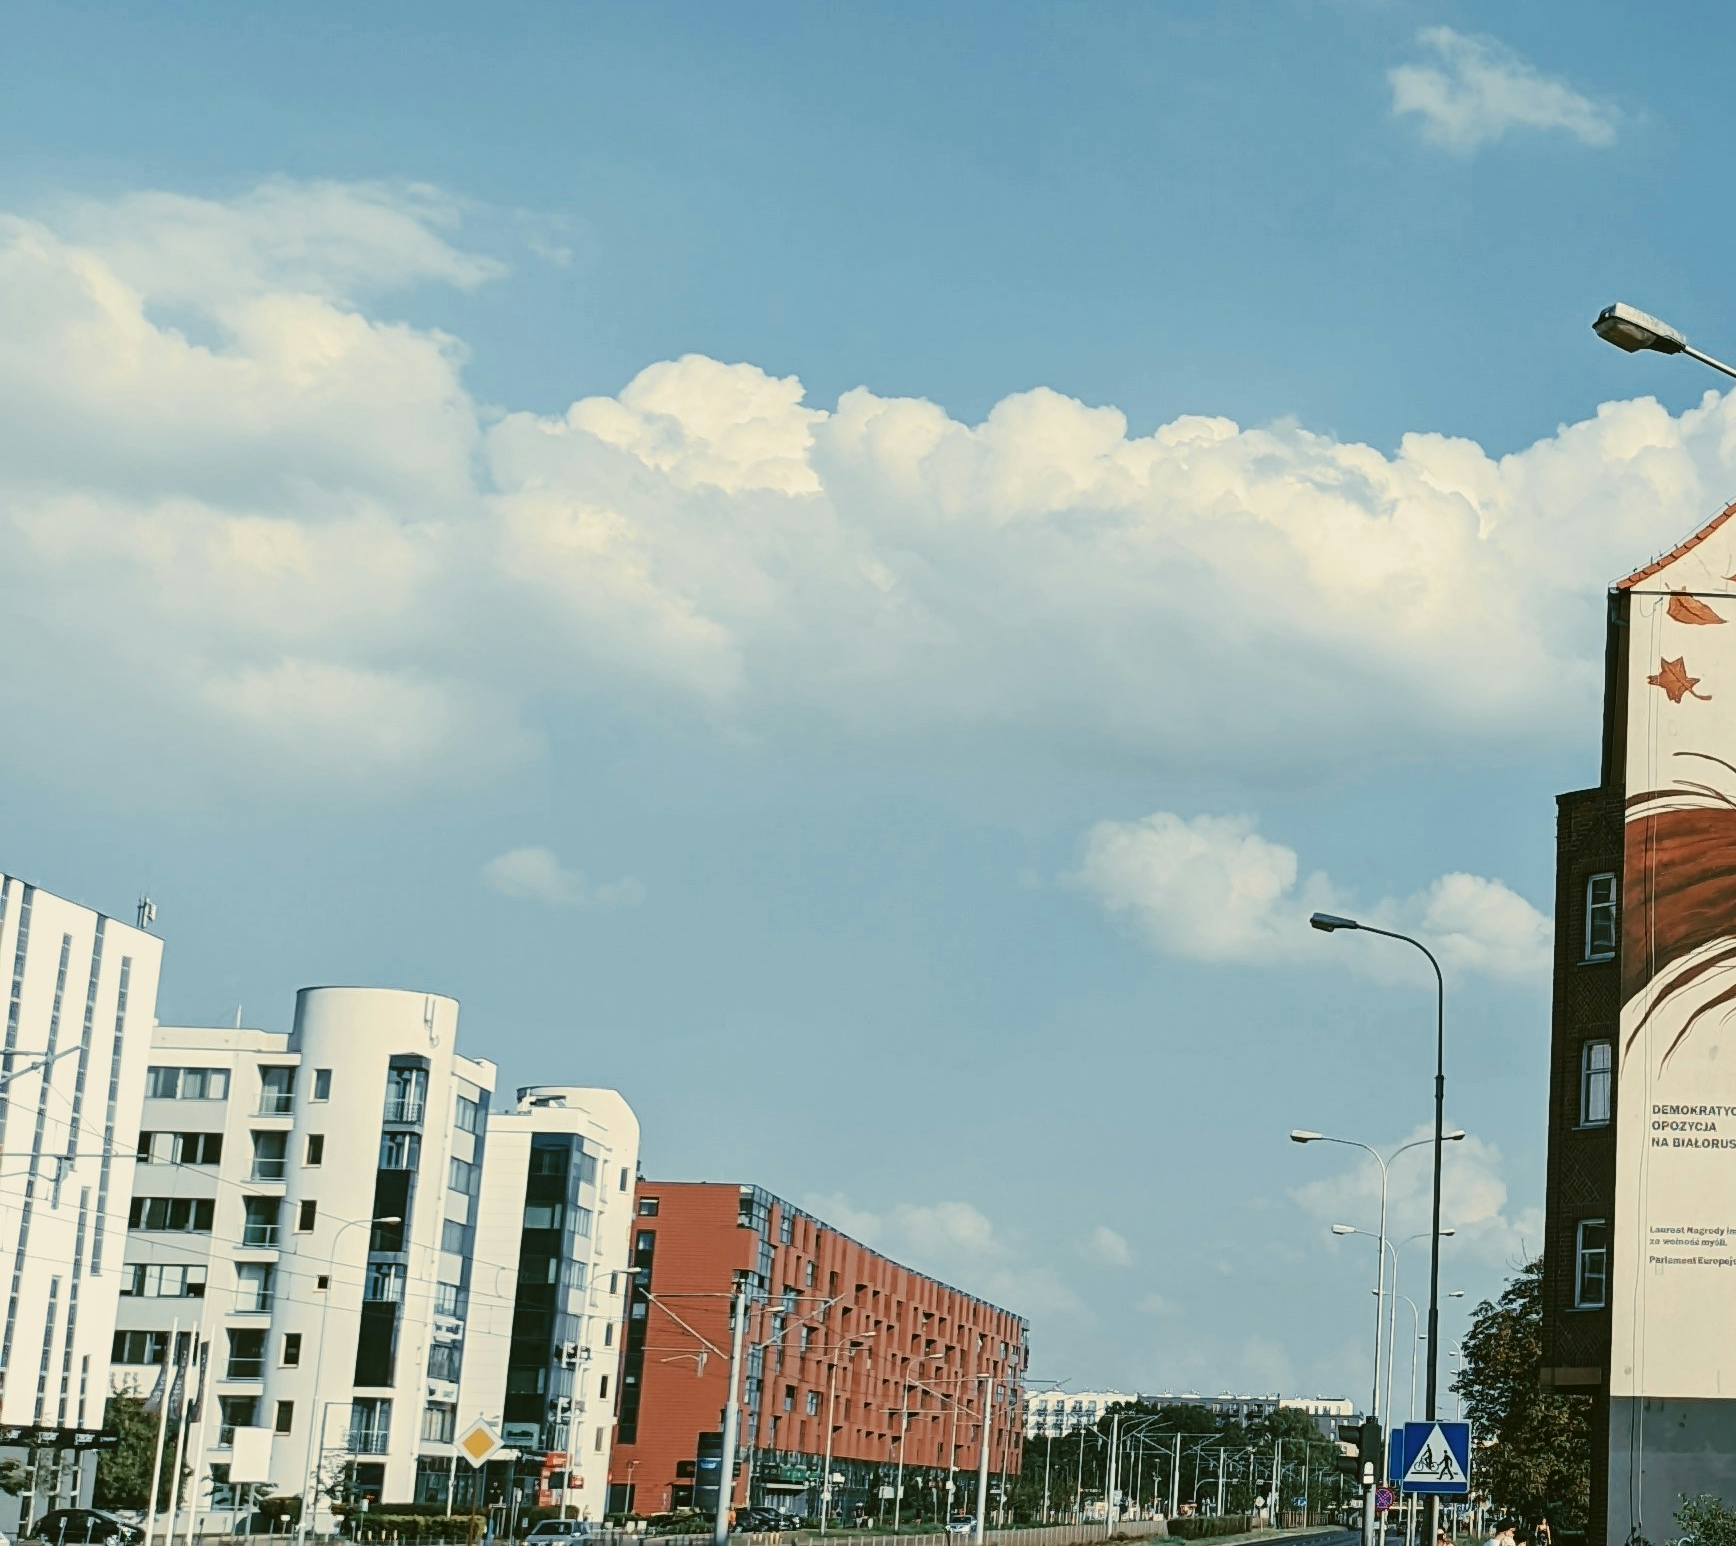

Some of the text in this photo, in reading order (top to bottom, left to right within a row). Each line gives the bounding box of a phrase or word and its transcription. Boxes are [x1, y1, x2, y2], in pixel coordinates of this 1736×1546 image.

[1651, 1120, 1717, 1132] OPOZYCJA
[1651, 1137, 1669, 1148] NA
[1686, 1226, 1725, 1236] Nagrody
[1649, 1256, 1696, 1265] Parlament
